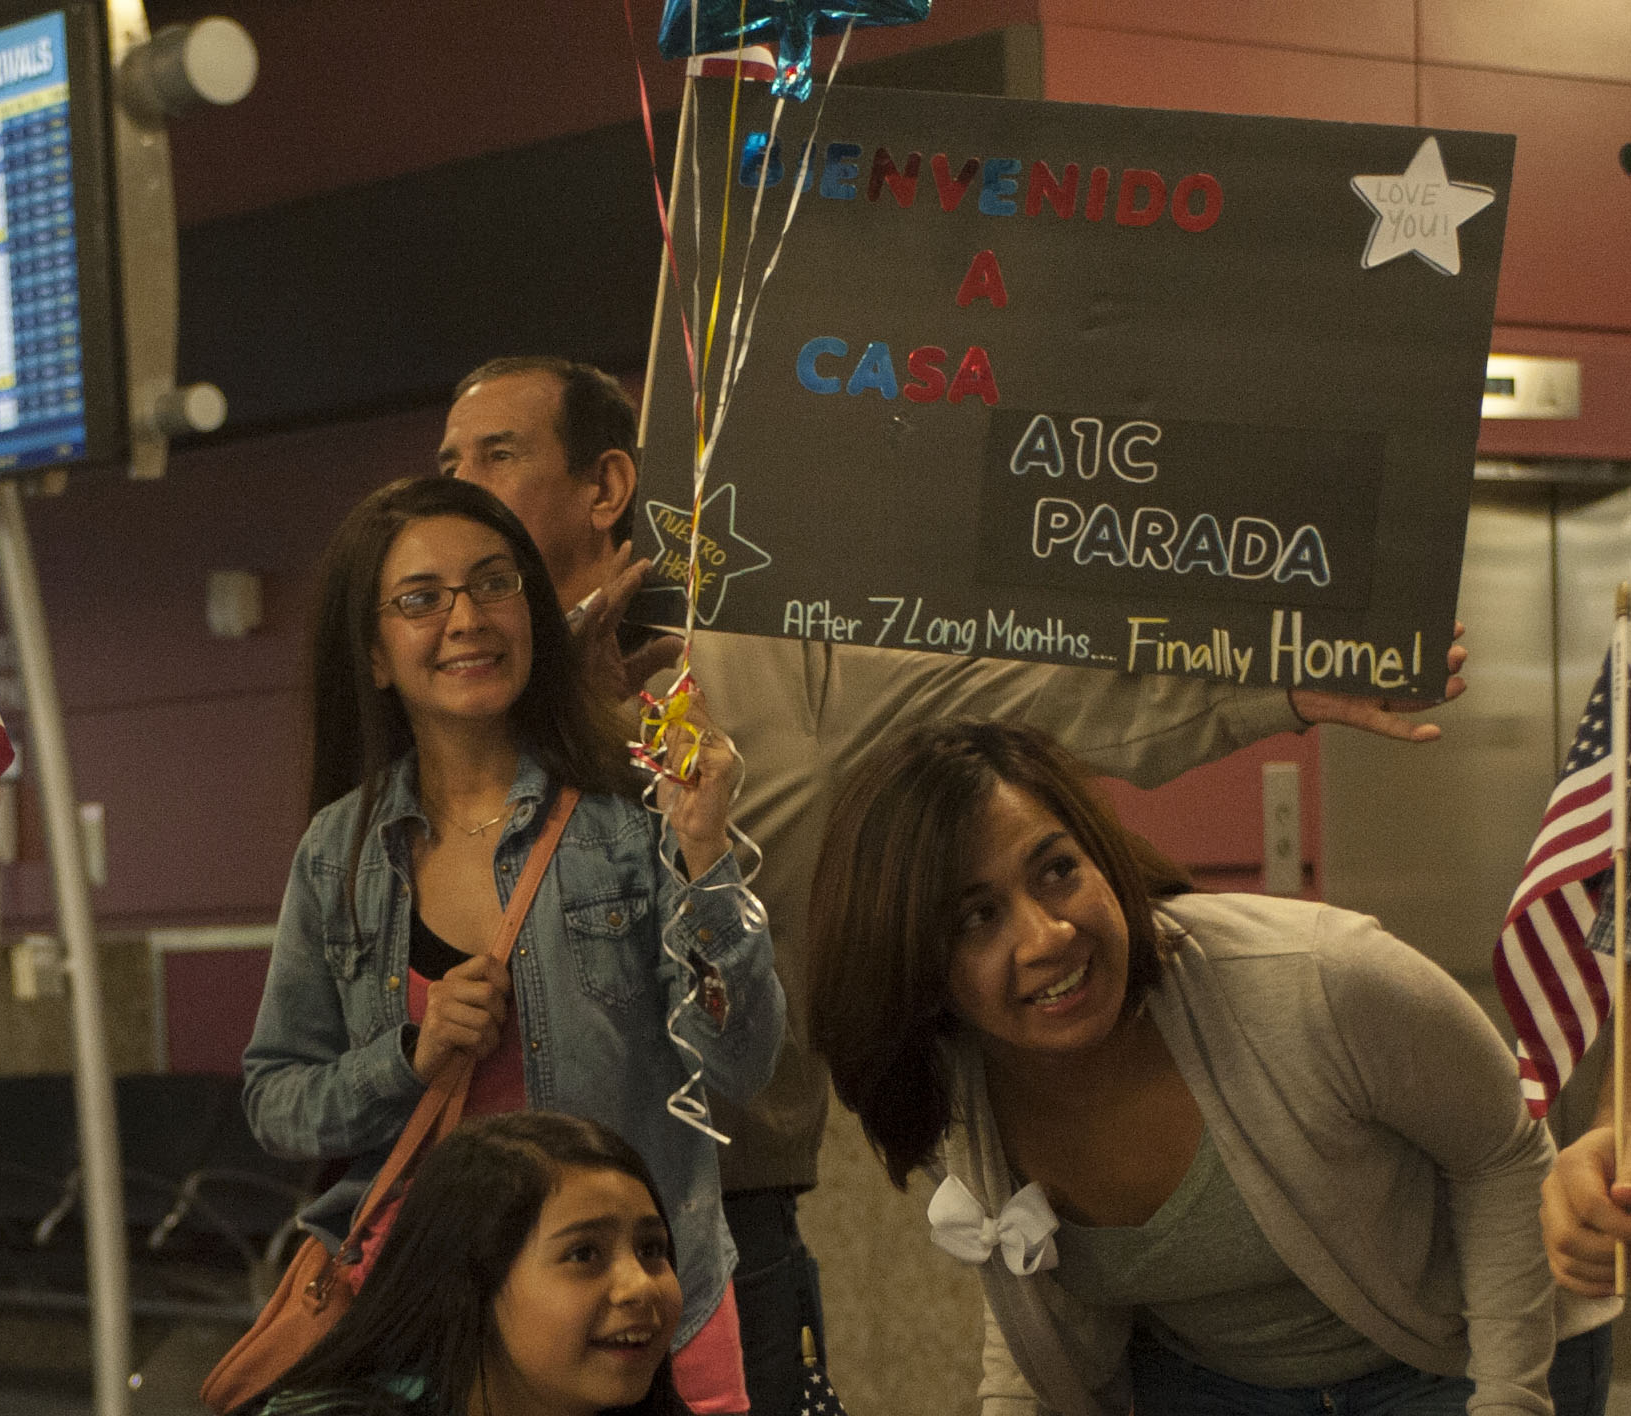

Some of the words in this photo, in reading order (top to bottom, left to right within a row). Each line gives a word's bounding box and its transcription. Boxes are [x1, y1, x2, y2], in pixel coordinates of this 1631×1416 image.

[738, 131, 1224, 232] BIENVENIDO
[1375, 181, 1441, 207] LOVE
[955, 248, 1008, 308] A
[795, 335, 1000, 406] CASA
[1008, 414, 1162, 482] A1C
[1032, 497, 1332, 587] PARADA
[782, 600, 863, 640] After
[868, 597, 905, 647] 7
[903, 597, 977, 654] Long
[1126, 616, 1254, 684] Finally
[1271, 609, 1422, 694] Home!
